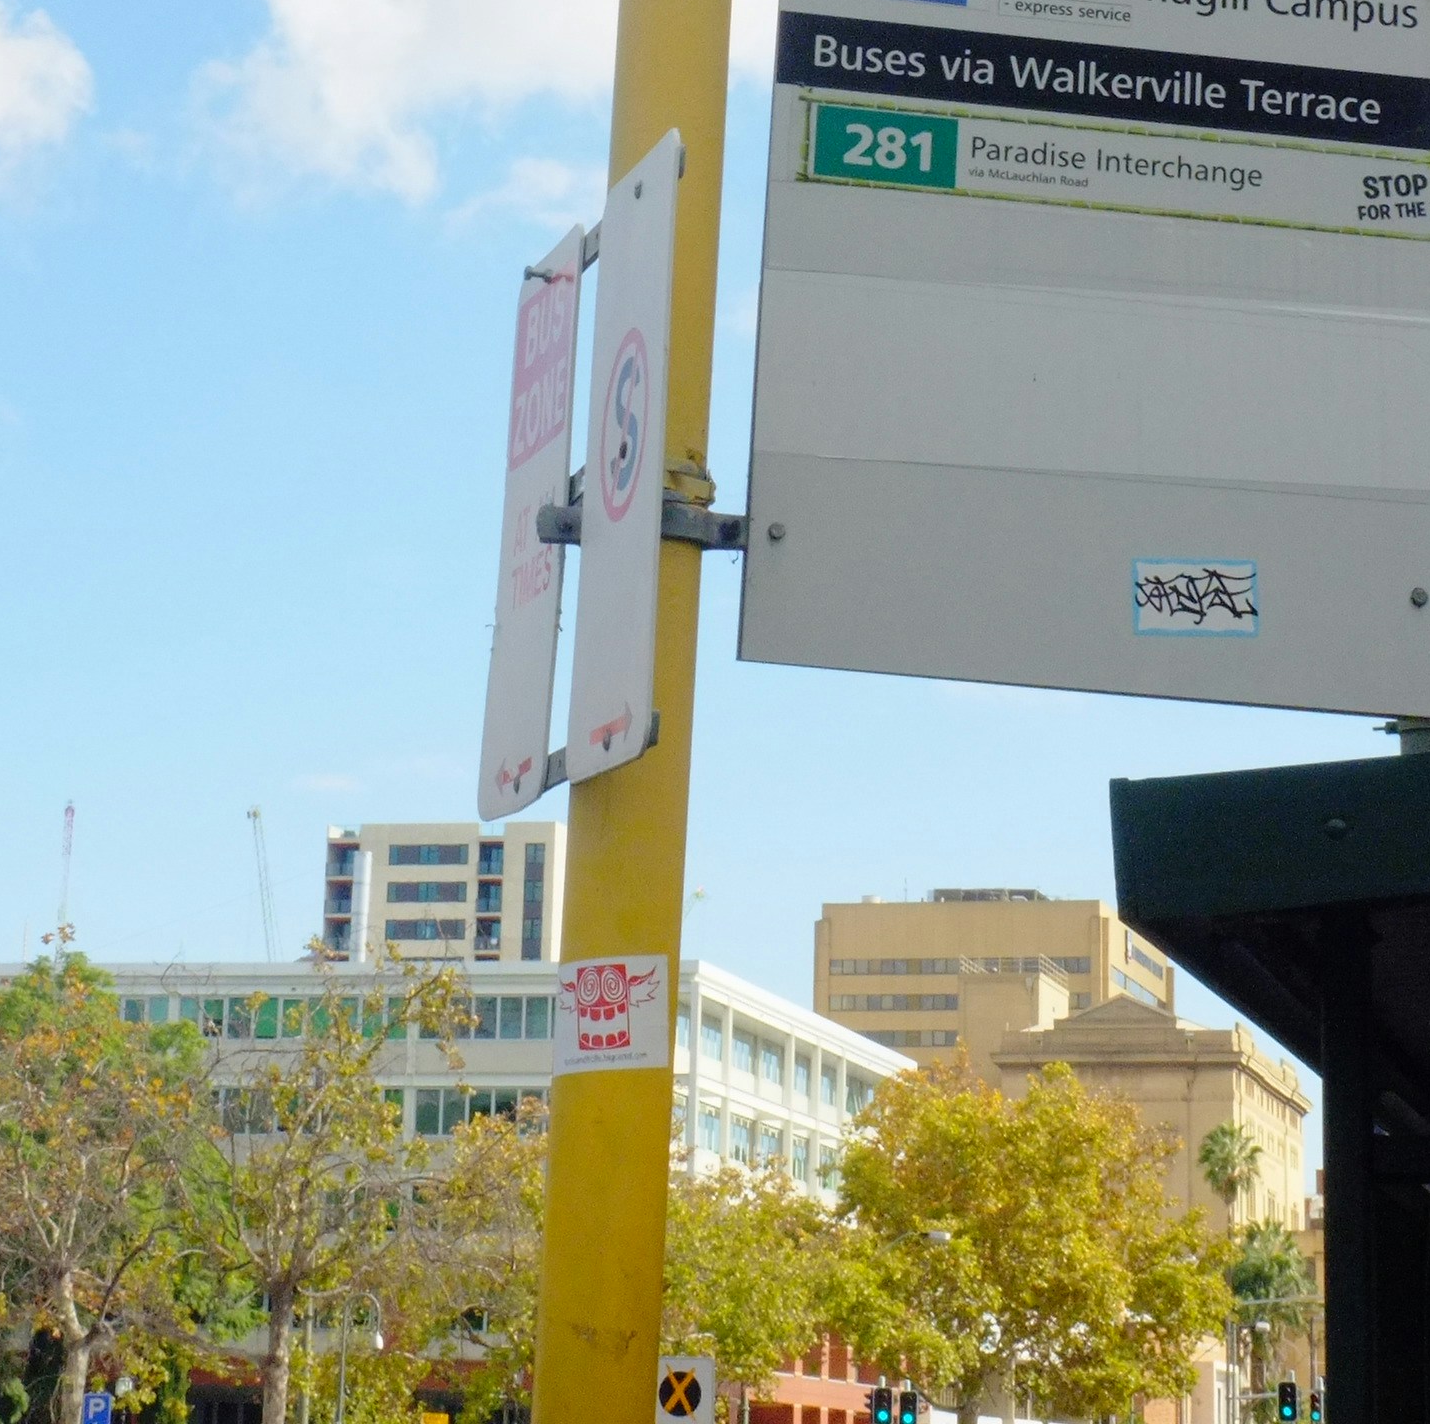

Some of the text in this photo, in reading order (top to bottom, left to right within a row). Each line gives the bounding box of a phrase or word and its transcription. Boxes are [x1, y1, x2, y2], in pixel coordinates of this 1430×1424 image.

[1015, 0, 1073, 18] express
[1077, 6, 1132, 23] service
[813, 34, 1382, 125] Buses via Walkerville Terrace
[842, 122, 933, 173] 281
[971, 136, 1263, 192] Paradise Interchange
[968, 166, 1089, 188] via McLauchlan Road
[1362, 174, 1428, 199] STOP
[1357, 204, 1391, 220] FOR
[1395, 201, 1427, 218] THE
[524, 278, 567, 370] BUS
[512, 356, 568, 456] ZONE
[511, 544, 553, 613] TIMES
[88, 1397, 105, 1419] P
